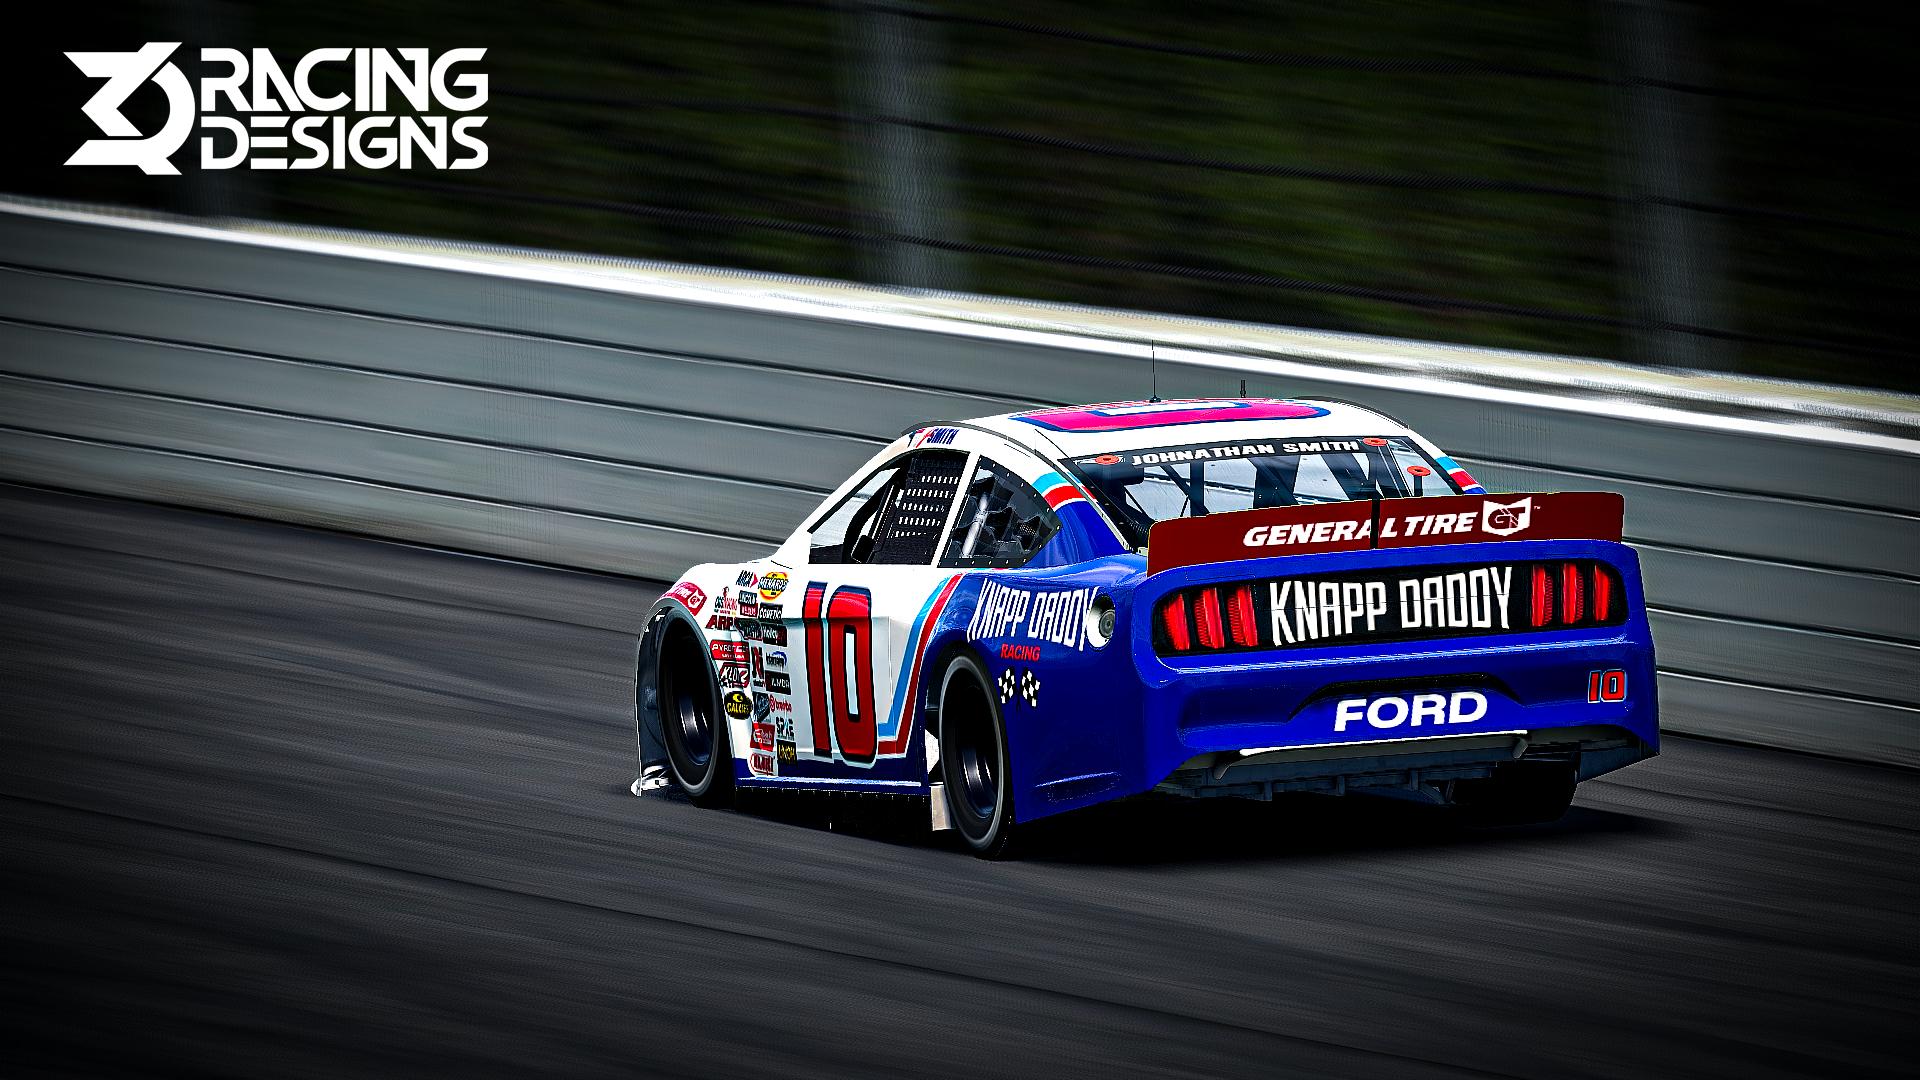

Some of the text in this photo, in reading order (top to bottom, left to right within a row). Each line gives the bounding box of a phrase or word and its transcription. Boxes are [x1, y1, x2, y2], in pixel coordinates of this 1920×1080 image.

[1131, 443, 1275, 466] JOHNATHAN
[1283, 441, 1360, 453] SMITH
[1243, 512, 1479, 547] GENERAL TIRE
[705, 615, 734, 630] ARP
[966, 577, 1100, 652] KNAPP DADDY
[1270, 567, 1512, 646] KNAPP DADDY
[1000, 643, 1041, 662] RACING
[802, 581, 878, 768] 10
[1587, 668, 1627, 703] 10
[1334, 691, 1487, 731] FORD
